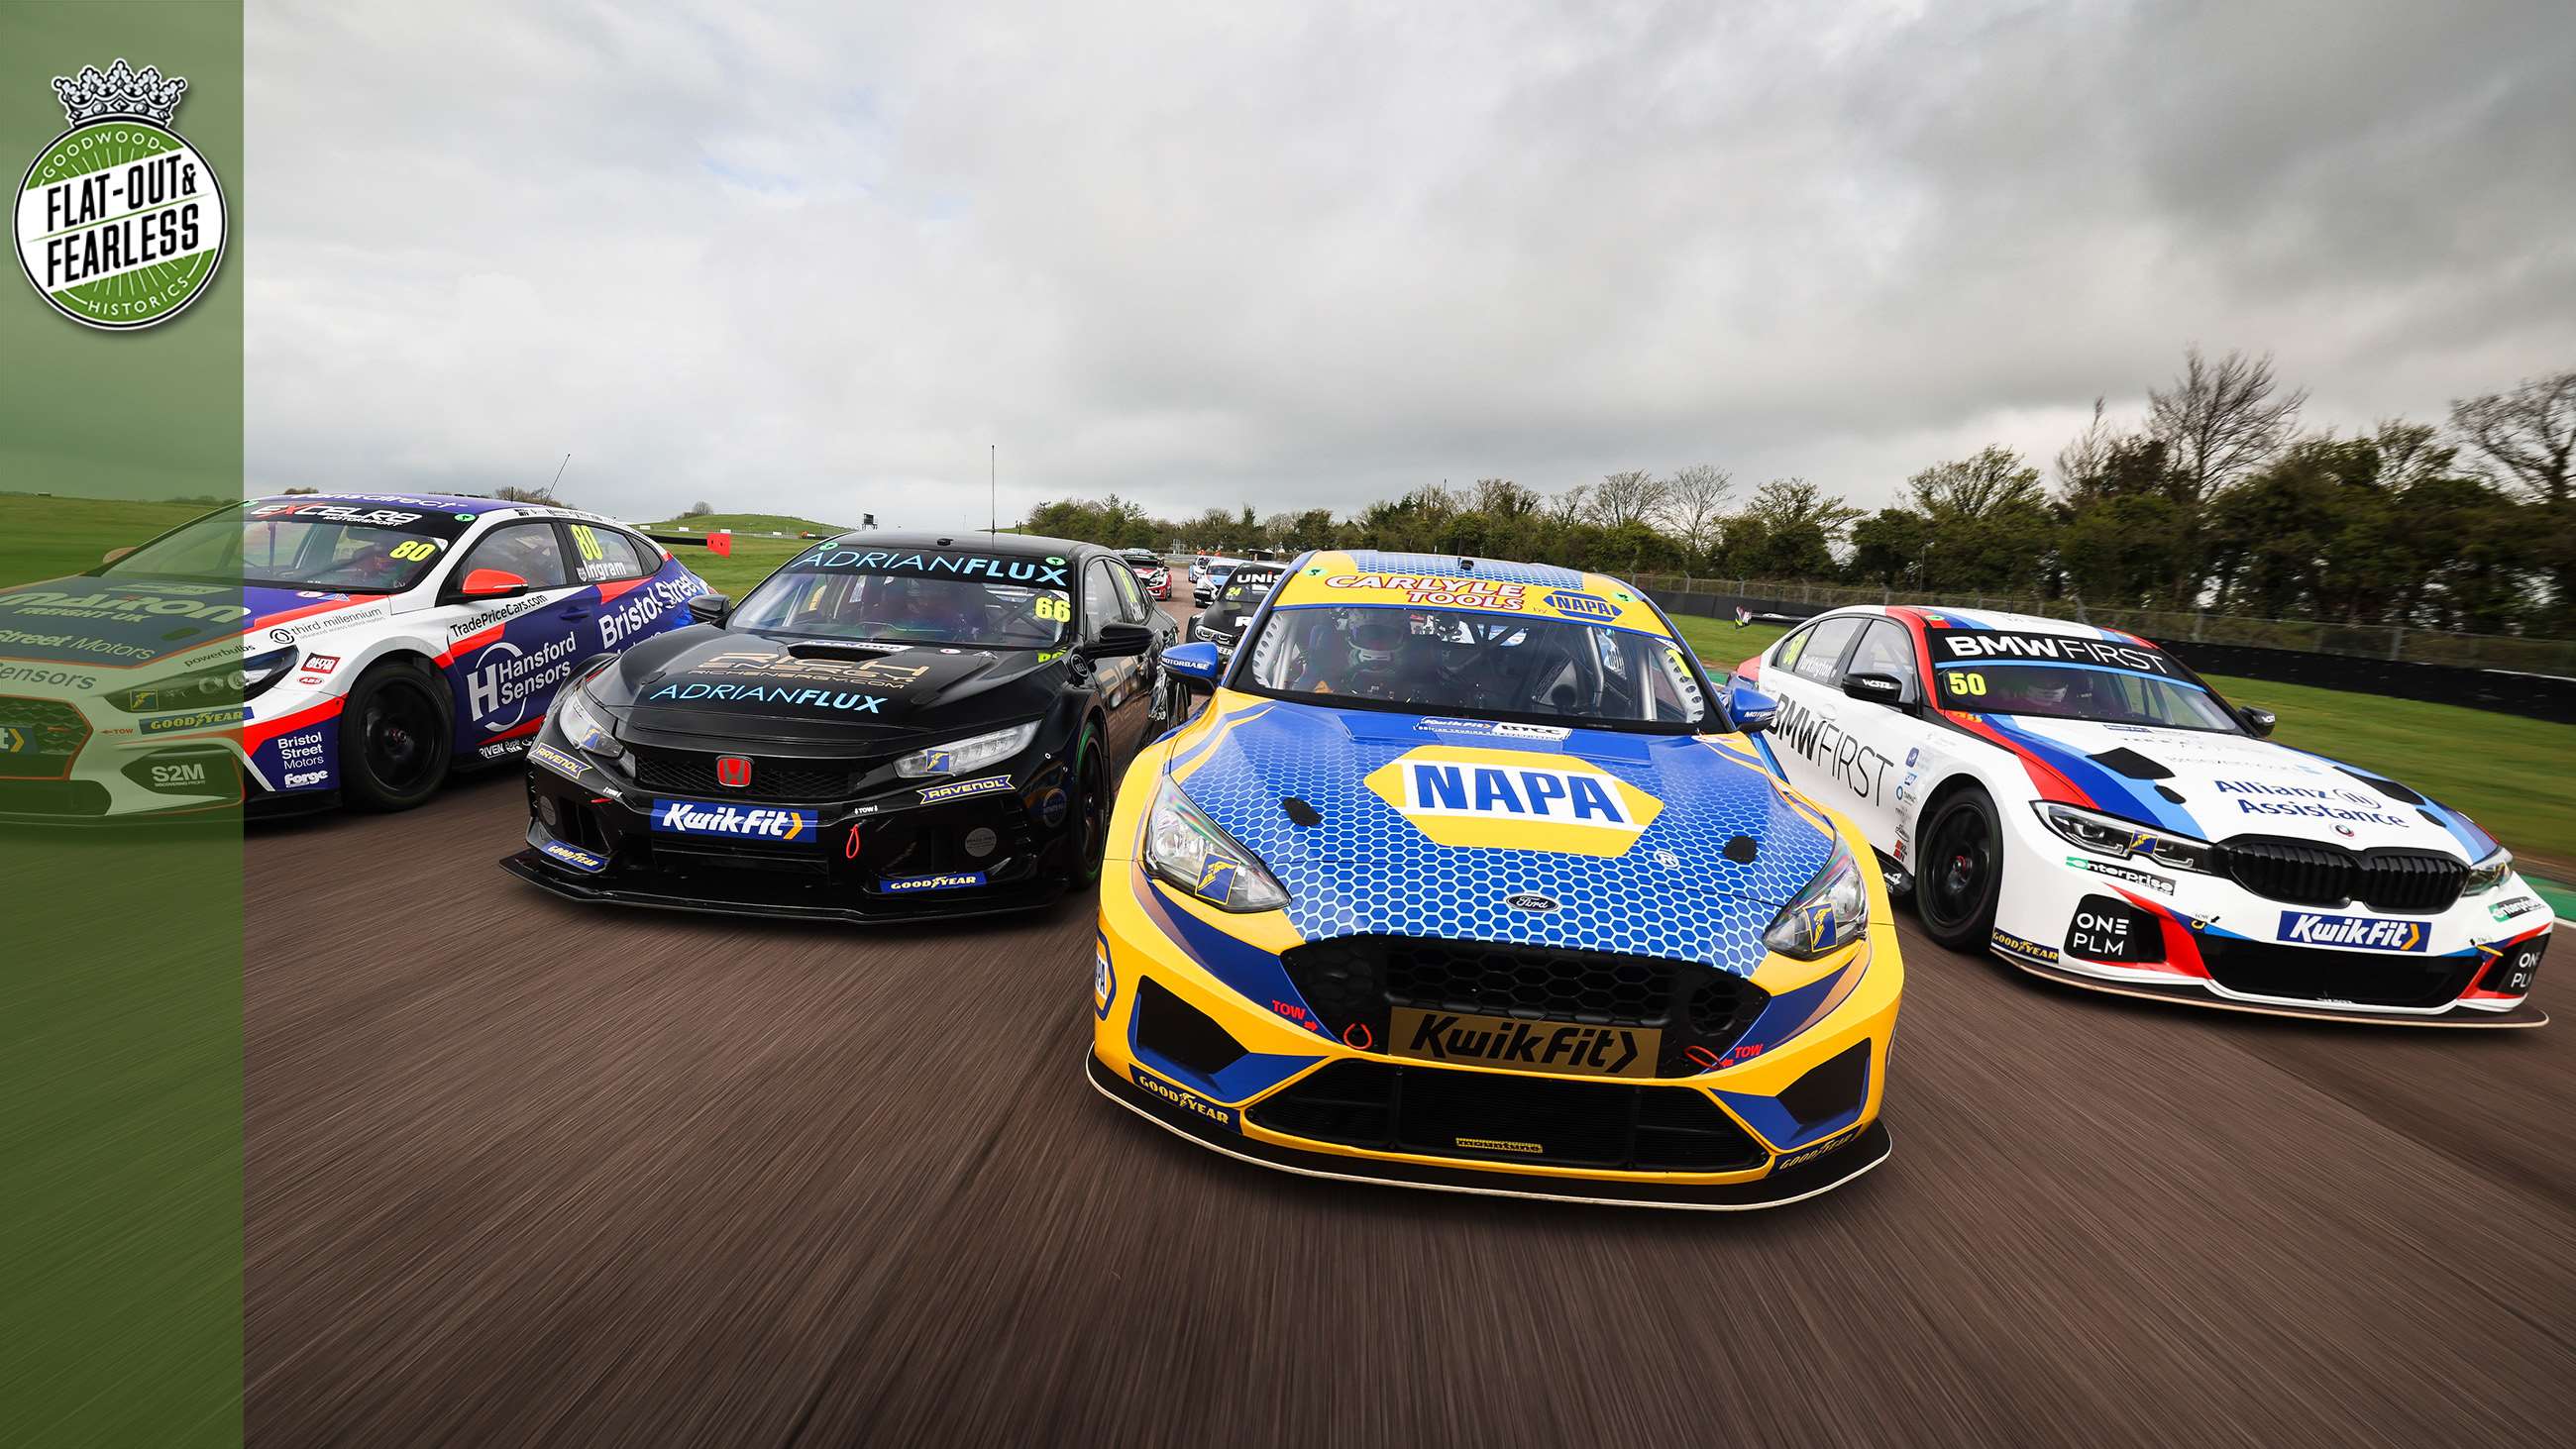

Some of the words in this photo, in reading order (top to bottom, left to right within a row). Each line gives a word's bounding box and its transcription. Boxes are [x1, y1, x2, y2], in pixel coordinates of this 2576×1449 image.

[251, 503, 422, 524] EXCELR8
[323, 516, 403, 527] MOTORSPORT
[389, 540, 436, 562] 80
[570, 524, 602, 562] 80
[585, 558, 627, 581] Ingram
[1325, 575, 1526, 596] CARLYLE
[1035, 597, 1071, 623] 66
[1407, 590, 1526, 611] TOOLS
[1556, 593, 1615, 615] NAPA
[291, 621, 321, 636] third
[323, 608, 382, 628] millennium
[450, 594, 548, 638] TradePriceCars.com
[597, 586, 663, 650] Bristol
[70, 637, 156, 661] Motors
[184, 644, 256, 668] powerbulbs
[499, 631, 577, 683] Hansford
[1160, 657, 1210, 671] MOTORBASE
[0, 662, 97, 691] ensors
[500, 662, 571, 705] Sensors
[1948, 672, 1986, 696] 50
[151, 710, 245, 731] GOODYEAR
[277, 732, 323, 749] Bristol
[281, 744, 324, 760] Street
[283, 756, 324, 770] Motors
[536, 747, 579, 773] RAVENOL
[152, 764, 205, 783] S2M
[284, 770, 328, 785] Forge
[928, 778, 1001, 800] RAVENOL
[1414, 764, 1625, 824] NAPA
[2214, 779, 2335, 800] Allianz
[2237, 797, 2411, 829] Assistance
[547, 845, 599, 868] GOODYEAR
[891, 875, 976, 889] GOODYEAR
[2069, 858, 2174, 890] enterprise
[1516, 894, 1550, 909] Ford
[2077, 912, 2129, 935] ONE
[1992, 929, 2059, 961] GOODYEAR
[2073, 933, 2124, 956] PLM
[1272, 999, 1307, 1021] TOW
[1735, 1043, 1764, 1059] TOW
[1138, 1075, 1230, 1125] GOODYEAR
[1458, 1138, 1542, 1153] mountune
[1779, 1134, 1855, 1171] GOODYEAR
